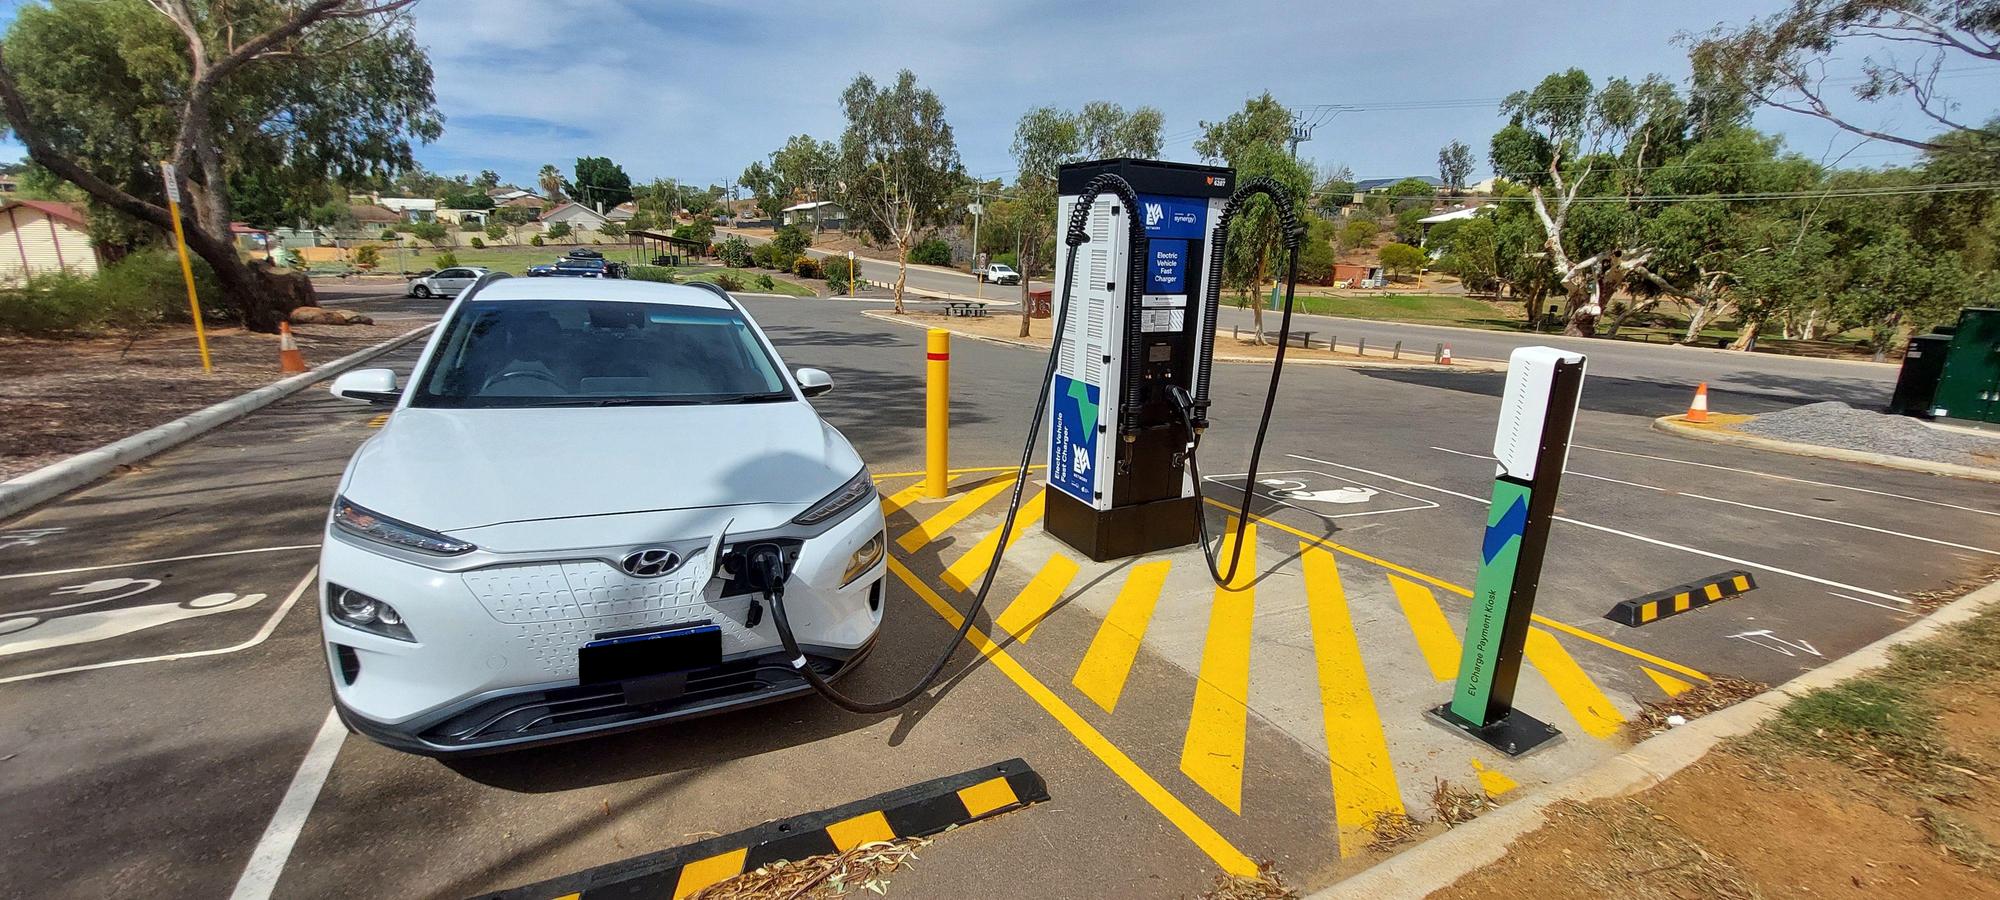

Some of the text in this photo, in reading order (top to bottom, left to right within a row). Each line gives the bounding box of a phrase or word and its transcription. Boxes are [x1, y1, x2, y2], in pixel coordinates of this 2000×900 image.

[1174, 216, 1195, 224] synergy
[1155, 275, 1177, 283] Charger
[1054, 446, 1062, 479] Electric
[1467, 588, 1497, 697] EV Charge Payment Kiosk
